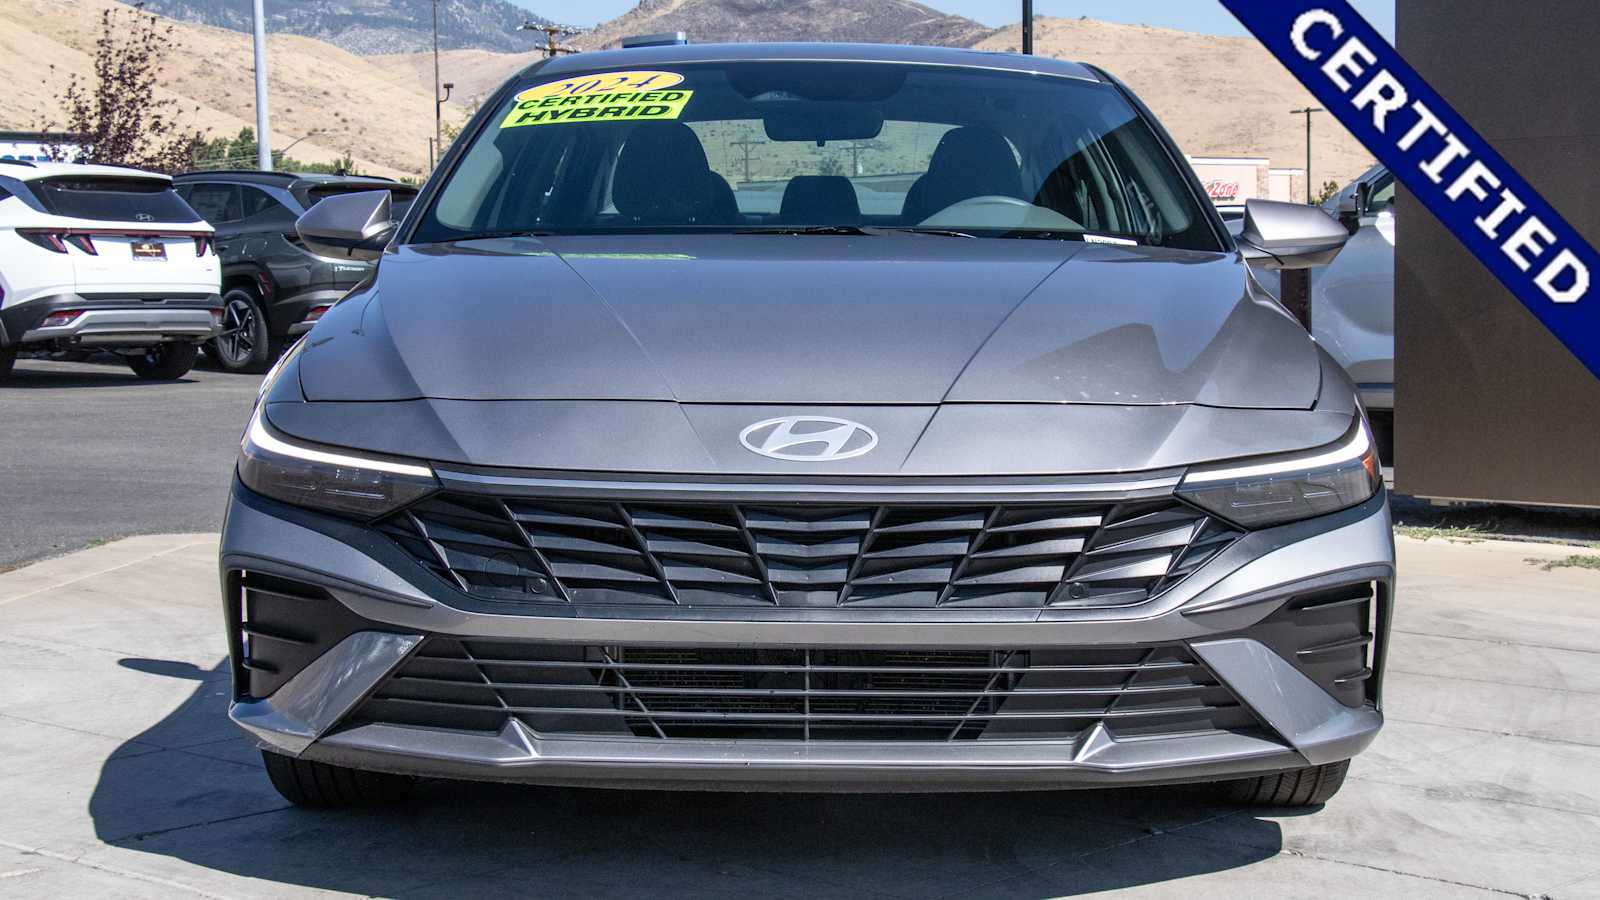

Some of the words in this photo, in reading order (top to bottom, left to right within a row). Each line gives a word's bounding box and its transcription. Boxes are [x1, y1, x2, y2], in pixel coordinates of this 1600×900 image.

[548, 75, 661, 96] 2024
[518, 92, 684, 110] CERTIFIED
[515, 105, 672, 123] HYBRID
